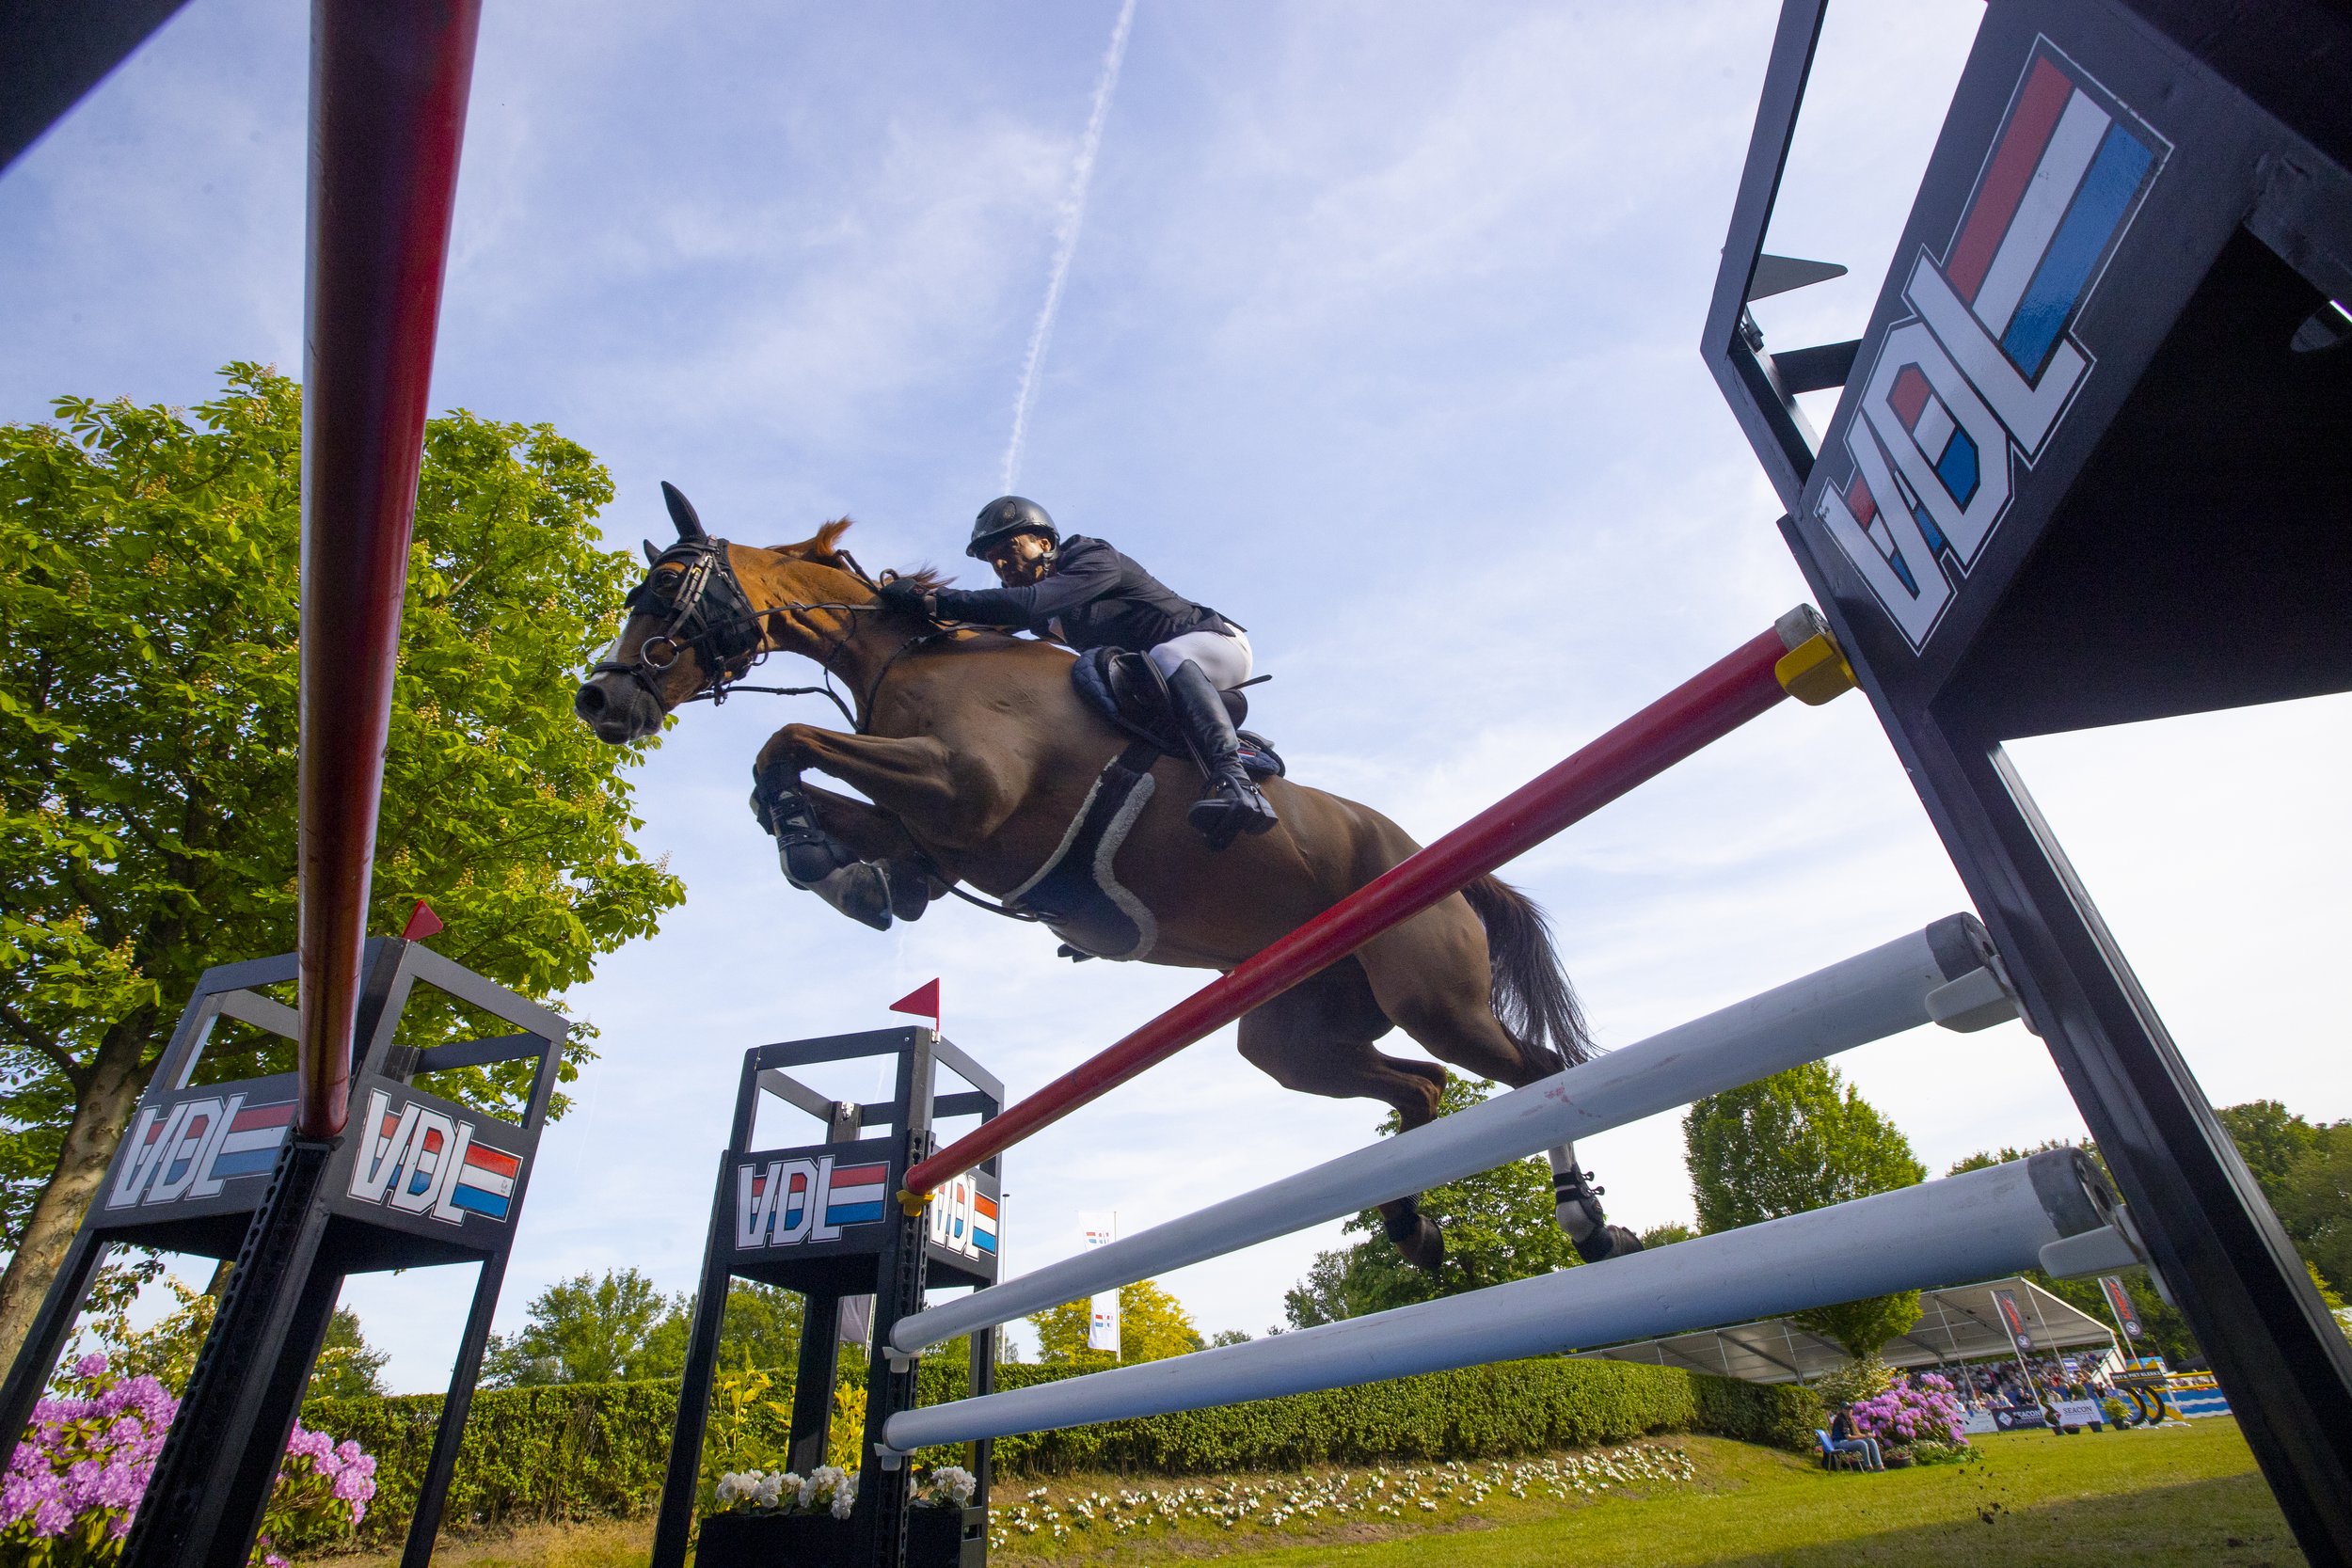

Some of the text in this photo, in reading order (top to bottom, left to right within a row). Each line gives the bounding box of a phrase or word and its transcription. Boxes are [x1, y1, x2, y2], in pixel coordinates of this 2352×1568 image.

[1815, 255, 2088, 647] VDL
[107, 1094, 246, 1209] VDL
[349, 1091, 473, 1225] VDL
[738, 1157, 841, 1248] VDL
[930, 1173, 978, 1260] VDL
[2012, 1409, 2042, 1418] SEACON
[2063, 1405, 2092, 1415] SEACON
